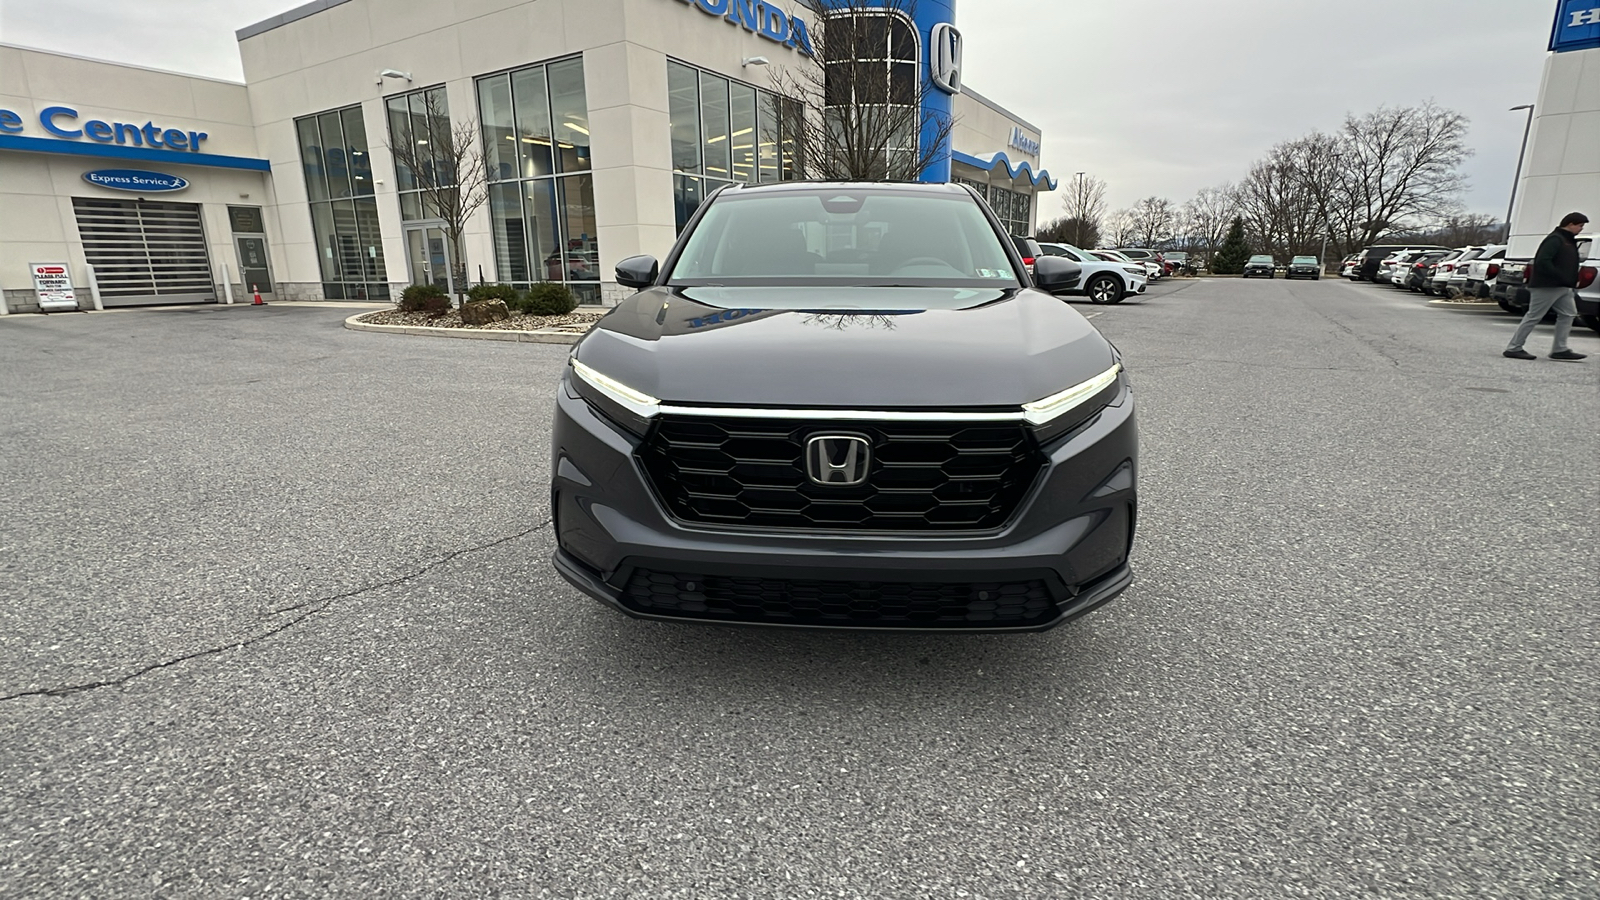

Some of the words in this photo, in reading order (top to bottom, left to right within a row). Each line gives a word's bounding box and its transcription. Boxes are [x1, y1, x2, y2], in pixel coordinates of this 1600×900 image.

[39, 106, 209, 151] Center
[90, 173, 131, 184] Express
[132, 176, 169, 186] Service
